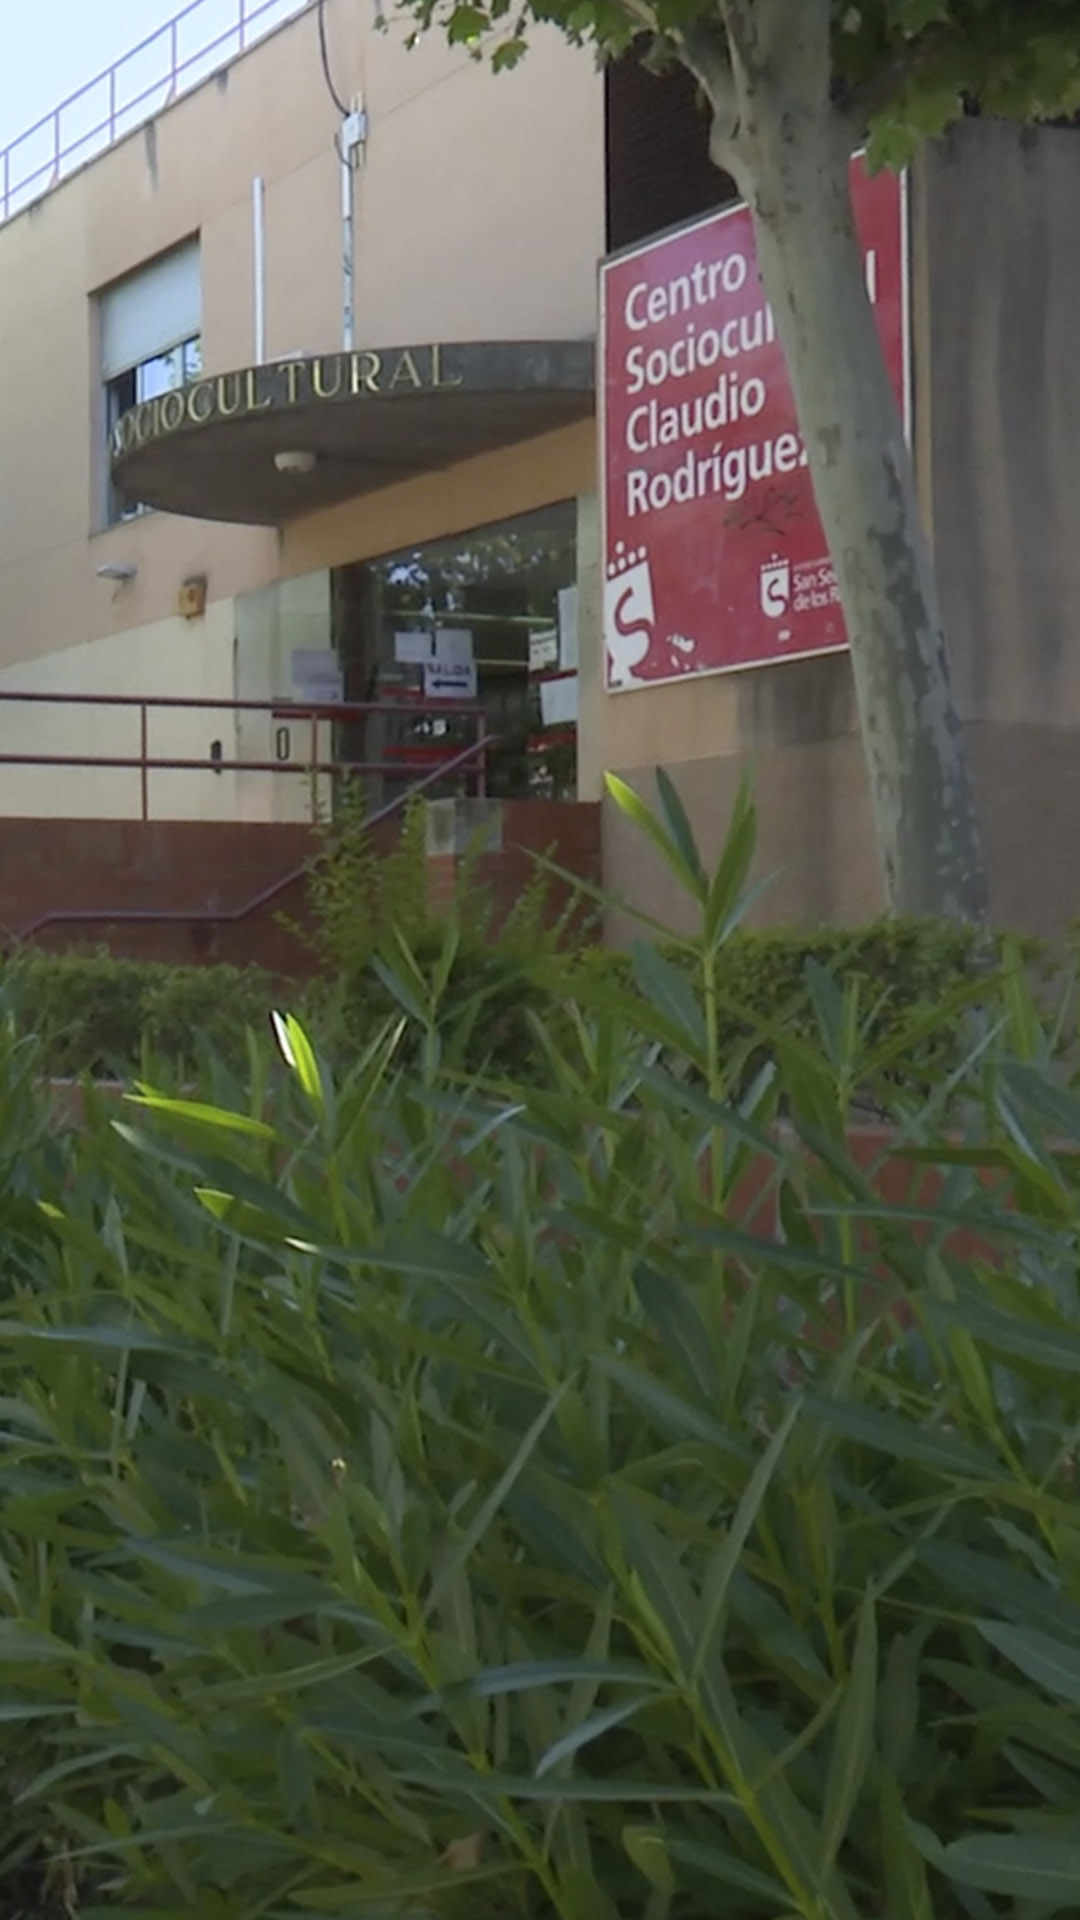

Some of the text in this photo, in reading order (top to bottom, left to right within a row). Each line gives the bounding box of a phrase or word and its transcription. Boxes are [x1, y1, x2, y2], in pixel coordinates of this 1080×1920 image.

[625, 253, 747, 332] Centro
[108, 344, 463, 458] SOCIOCULTURAL
[626, 371, 766, 453] Claudio
